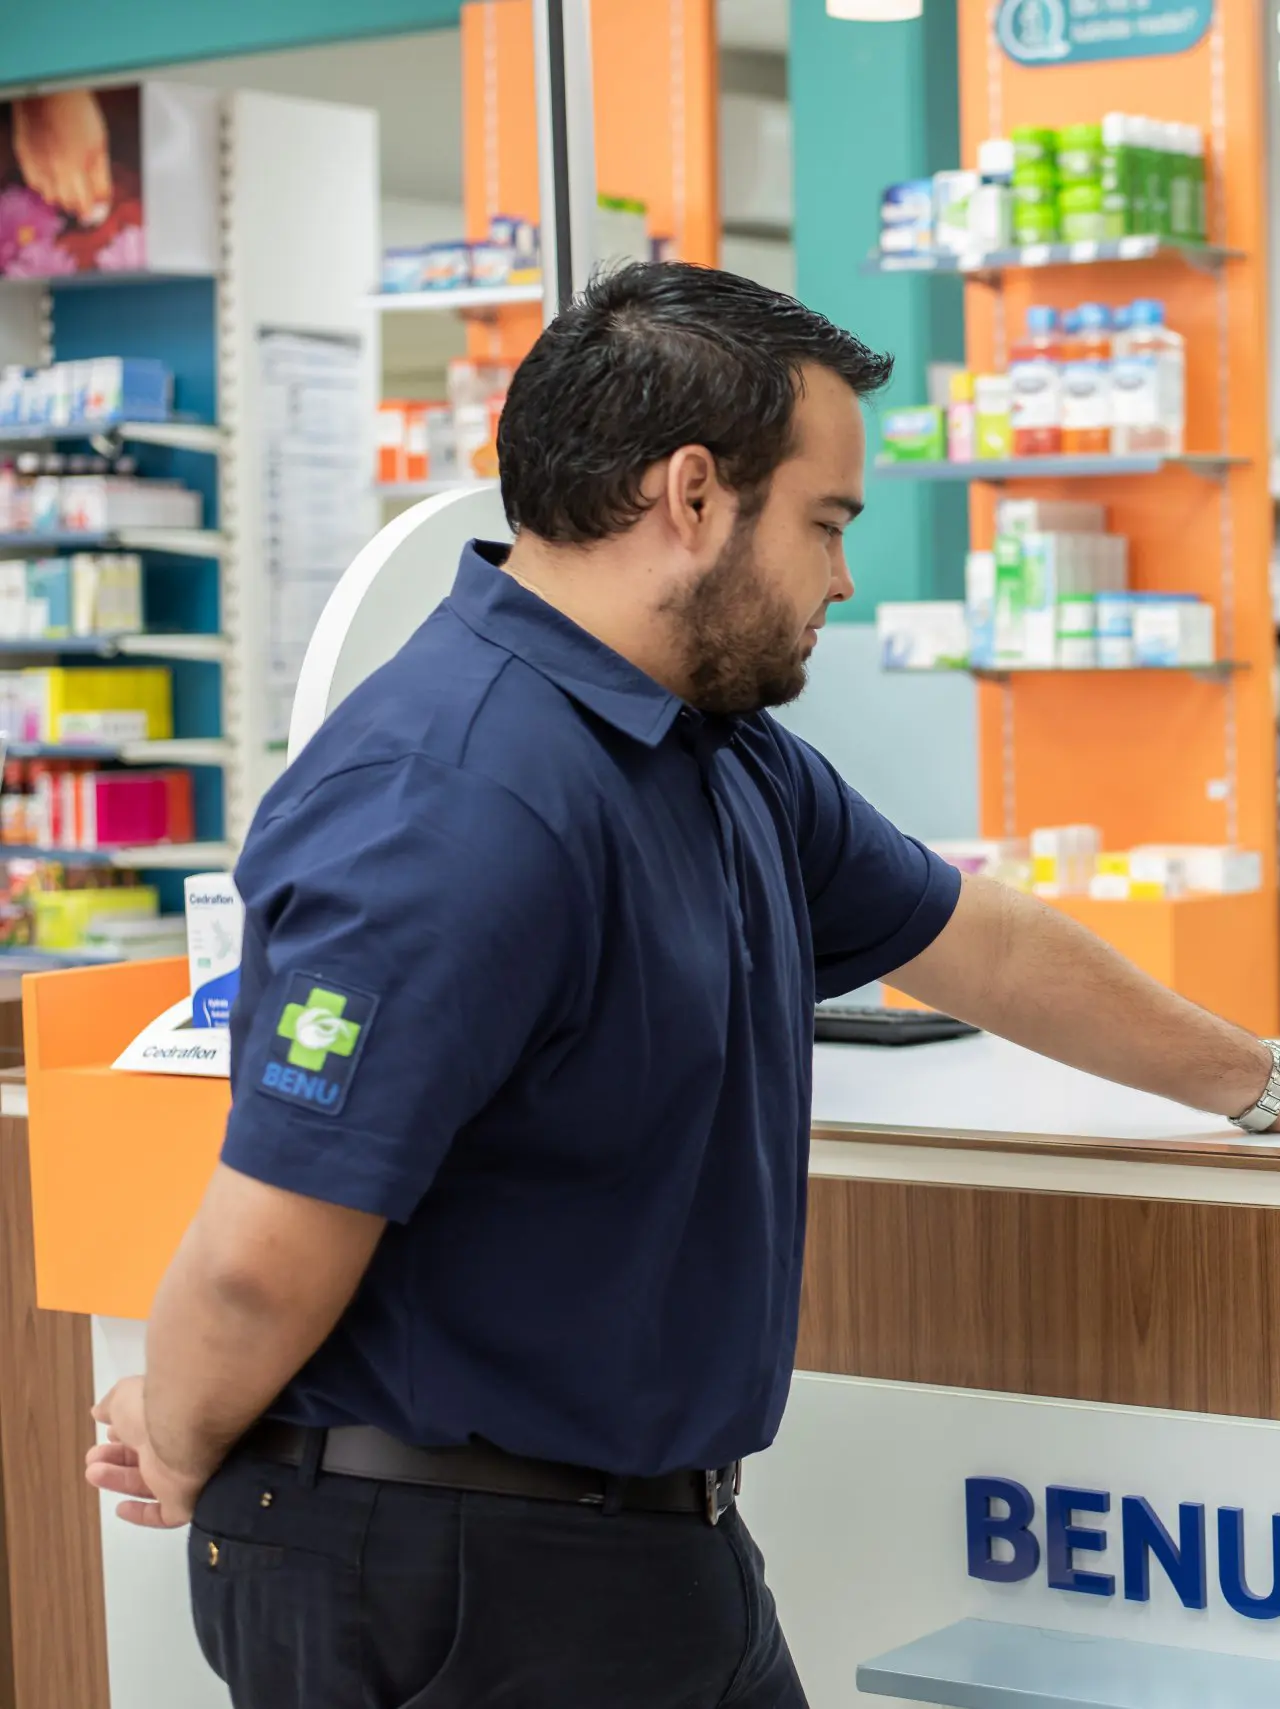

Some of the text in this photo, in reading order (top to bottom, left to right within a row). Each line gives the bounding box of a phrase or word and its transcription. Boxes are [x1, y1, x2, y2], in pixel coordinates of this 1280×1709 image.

[189, 893, 234, 905] Cedraflon
[142, 1046, 217, 1060] Cedraflon
[262, 1061, 340, 1105] BENU
